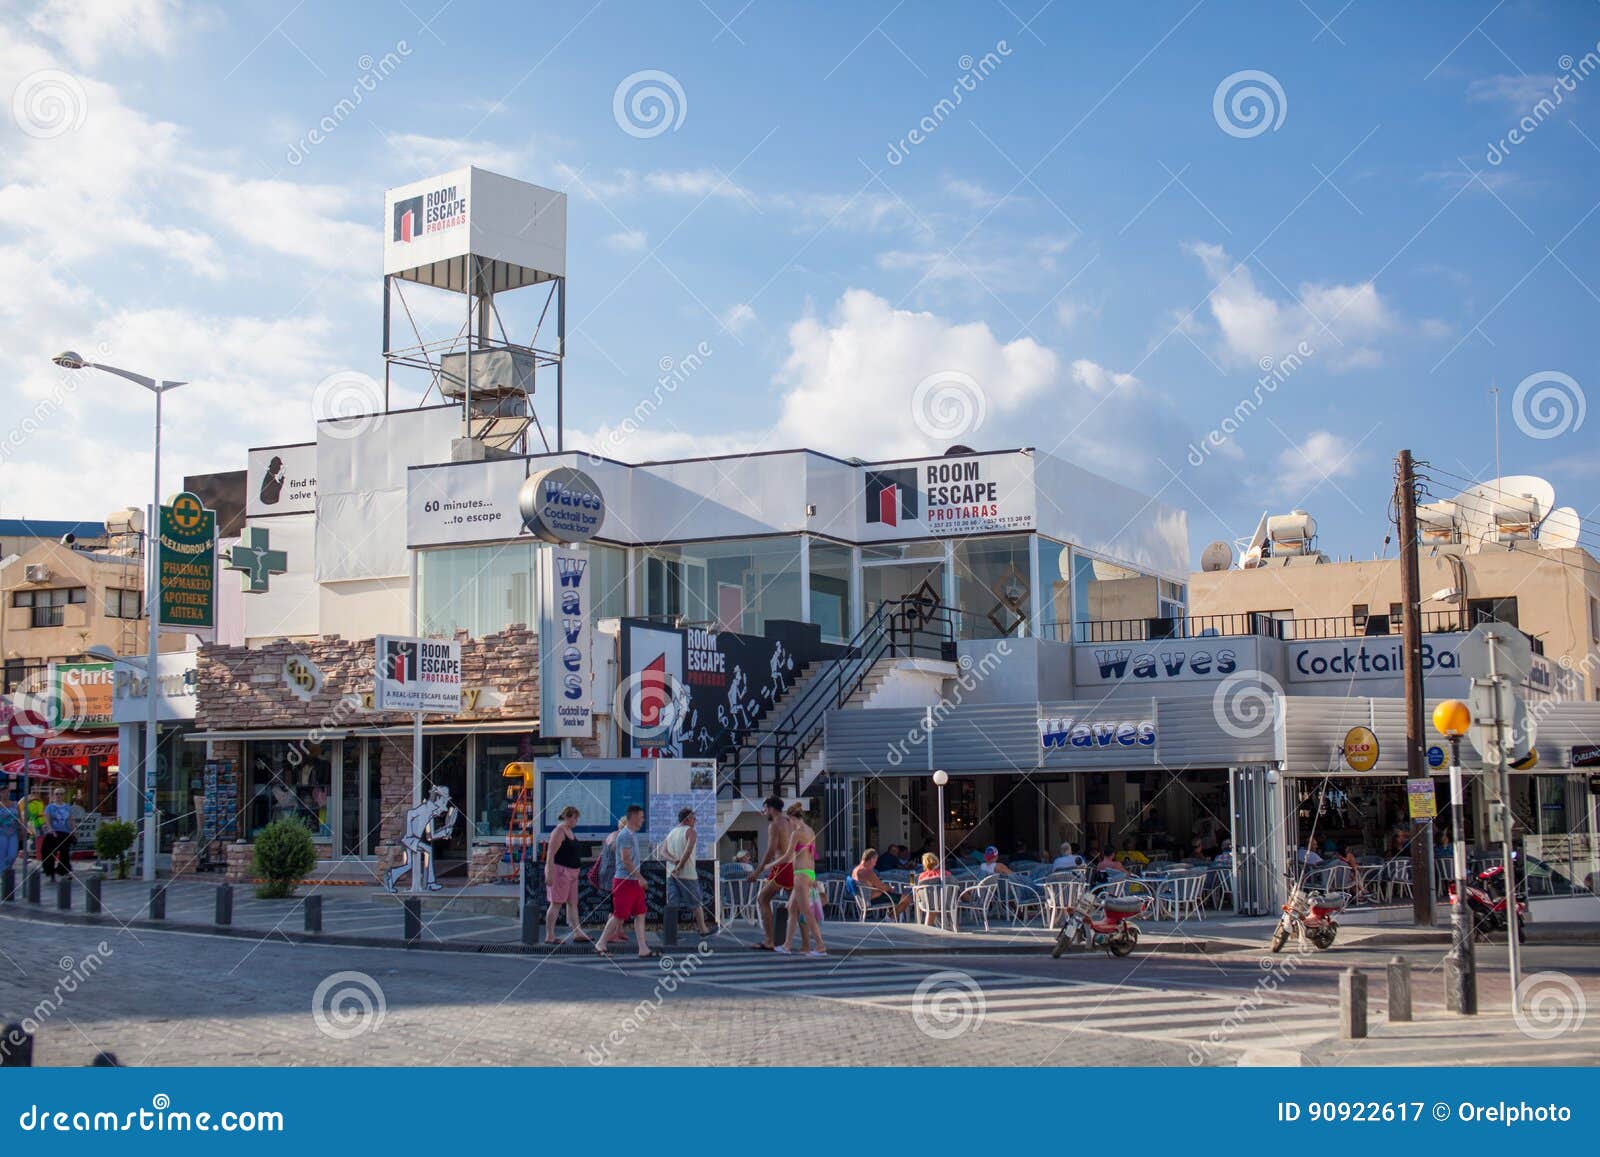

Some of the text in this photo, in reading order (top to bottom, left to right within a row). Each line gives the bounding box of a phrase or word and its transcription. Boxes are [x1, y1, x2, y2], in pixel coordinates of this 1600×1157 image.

[427, 186, 457, 208] ROOM
[427, 198, 466, 224] ESCAPE
[426, 214, 466, 234] PROTARAS
[927, 461, 979, 485] ROOM
[290, 478, 307, 488] find
[289, 491, 312, 500] solve
[545, 480, 601, 511] Waves
[927, 482, 997, 507] ESCAPE
[424, 500, 493, 512] 60 minutes...
[928, 504, 998, 521] PROTARAS
[466, 512, 502, 523] escape
[544, 507, 597, 524] Cocktail bar
[576, 524, 590, 533] bar
[162, 562, 210, 577] PHARMACY
[556, 557, 588, 700] Waves
[687, 628, 717, 651] ROOM
[421, 643, 450, 659] ROOM
[421, 659, 459, 674] ESCAPE
[687, 651, 726, 673] ESCAPE
[1094, 648, 1237, 679] Waves
[1296, 646, 1404, 675] Cocktail
[421, 672, 459, 684] PROTARAS
[420, 692, 441, 700] ESCAPE
[1037, 718, 1158, 749] Waves
[40, 744, 76, 757] KIOSK
[1347, 744, 1370, 752] KEO
